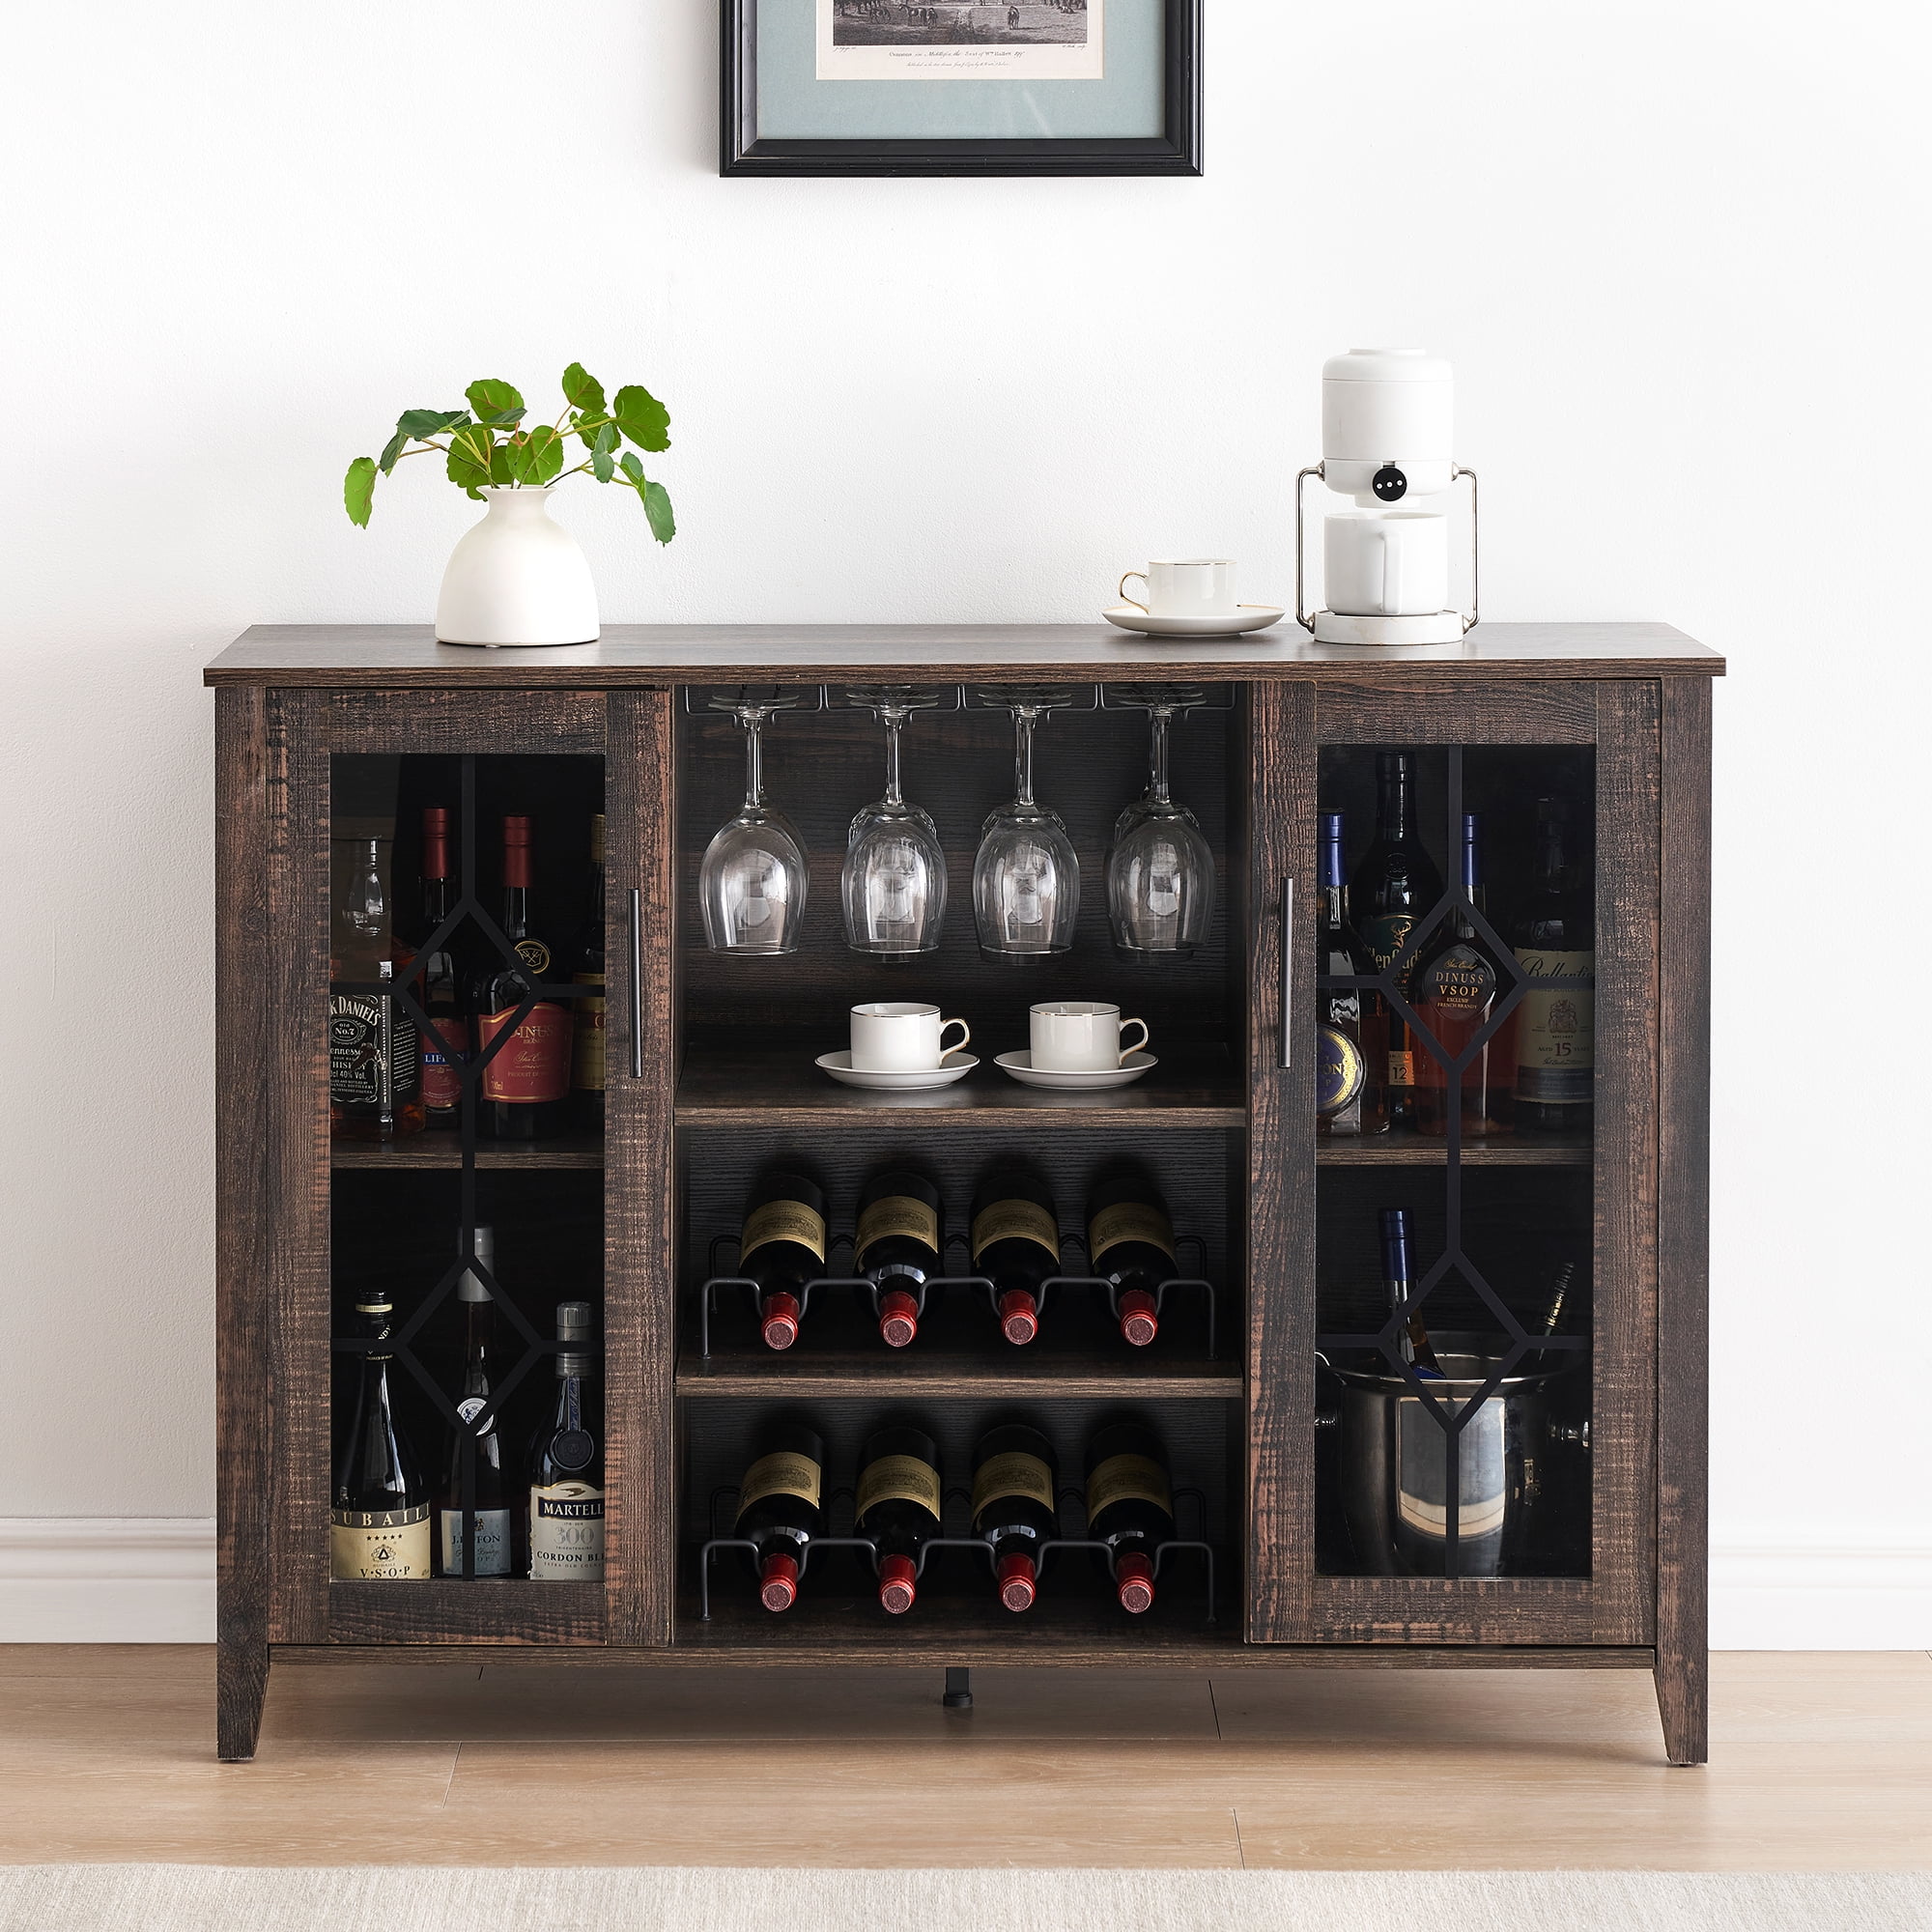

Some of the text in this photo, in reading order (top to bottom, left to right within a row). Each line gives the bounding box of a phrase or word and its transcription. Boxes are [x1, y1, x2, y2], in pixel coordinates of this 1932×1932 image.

[1435, 972, 1484, 984] DINUSS
[1439, 984, 1479, 997] VSOP
[338, 996, 382, 1027] DANIEL'S
[1555, 1042, 1572, 1057] 15
[1392, 1067, 1407, 1079] 12
[544, 1502, 604, 1516] MARTELL
[554, 1526, 595, 1546] 300
[537, 1550, 582, 1562] CORDON
